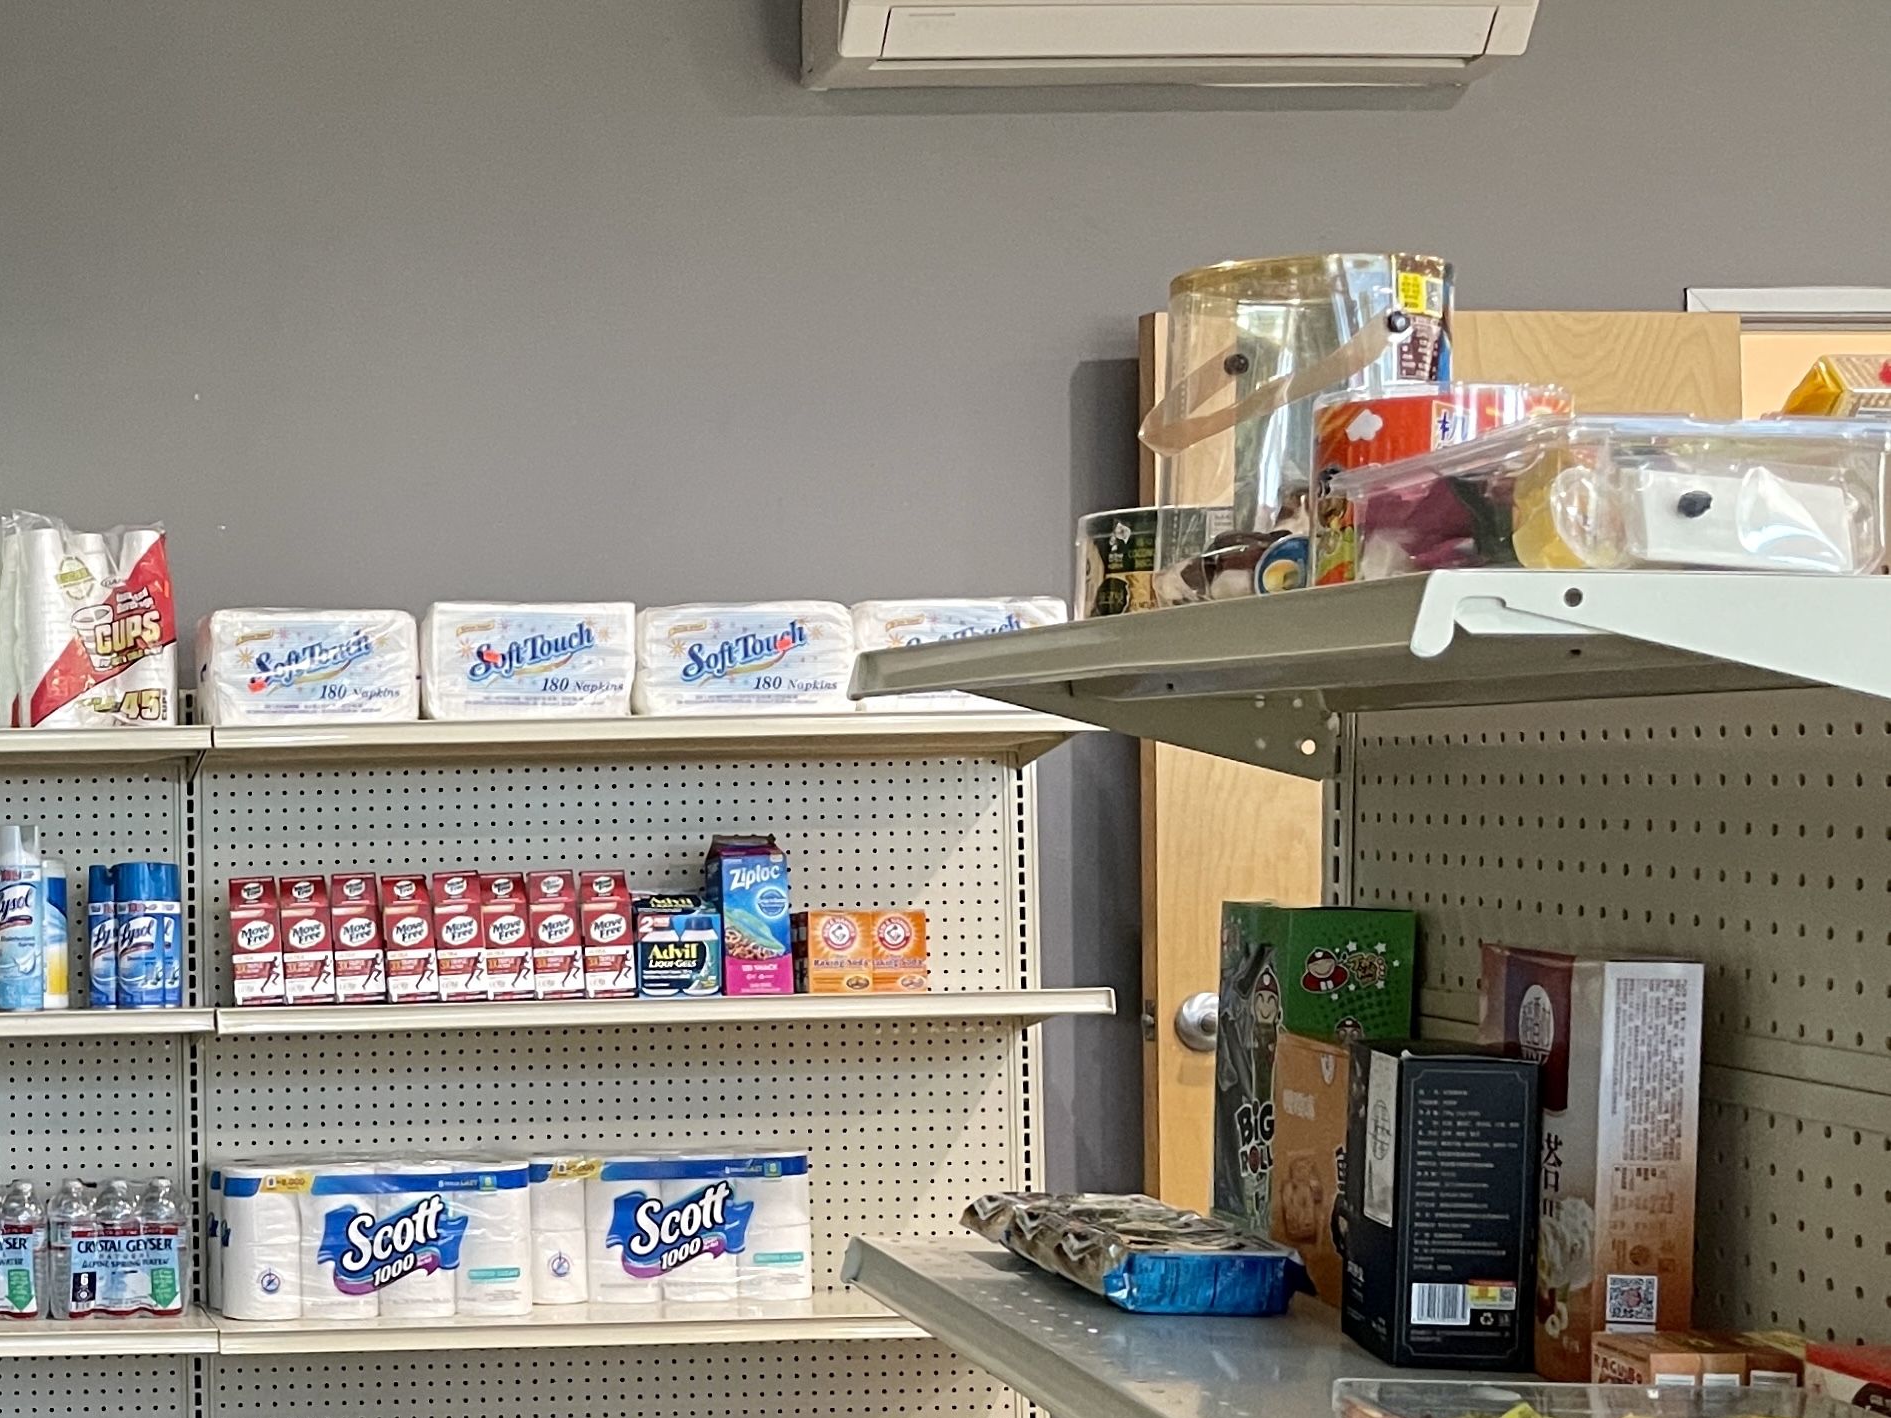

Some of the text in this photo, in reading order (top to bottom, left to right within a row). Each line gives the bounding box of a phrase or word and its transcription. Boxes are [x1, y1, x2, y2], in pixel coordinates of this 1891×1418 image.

[94, 610, 162, 656] CUPS
[542, 678, 624, 693] 180 Napkins
[754, 676, 838, 692] 180 Napkins
[320, 685, 401, 701] 180 Napkins
[120, 688, 161, 721] 45
[729, 864, 781, 892] Ziploc
[293, 923, 321, 937] Move
[344, 921, 373, 936] Move
[396, 920, 424, 934] Move
[445, 919, 474, 932] Move
[493, 919, 522, 932] Move
[542, 918, 570, 931] Move
[594, 917, 623, 930] Move
[639, 918, 654, 932] 2
[120, 918, 154, 949] Lysol
[241, 924, 270, 938] Move
[298, 931, 321, 944] Free
[349, 930, 372, 943] Free
[401, 929, 424, 942] Free
[451, 928, 474, 941] Free
[498, 928, 521, 941] Free
[547, 927, 570, 940] Free
[599, 926, 622, 939] Free
[247, 932, 270, 945] Free
[648, 944, 698, 960] Advil
[630, 1184, 730, 1256] Scott
[341, 1195, 444, 1272] Scott
[77, 1238, 173, 1253] CRYSTAL GEYSER
[661, 1237, 701, 1271] 1000
[373, 1253, 415, 1287] 1000
[80, 1273, 89, 1286] 6
